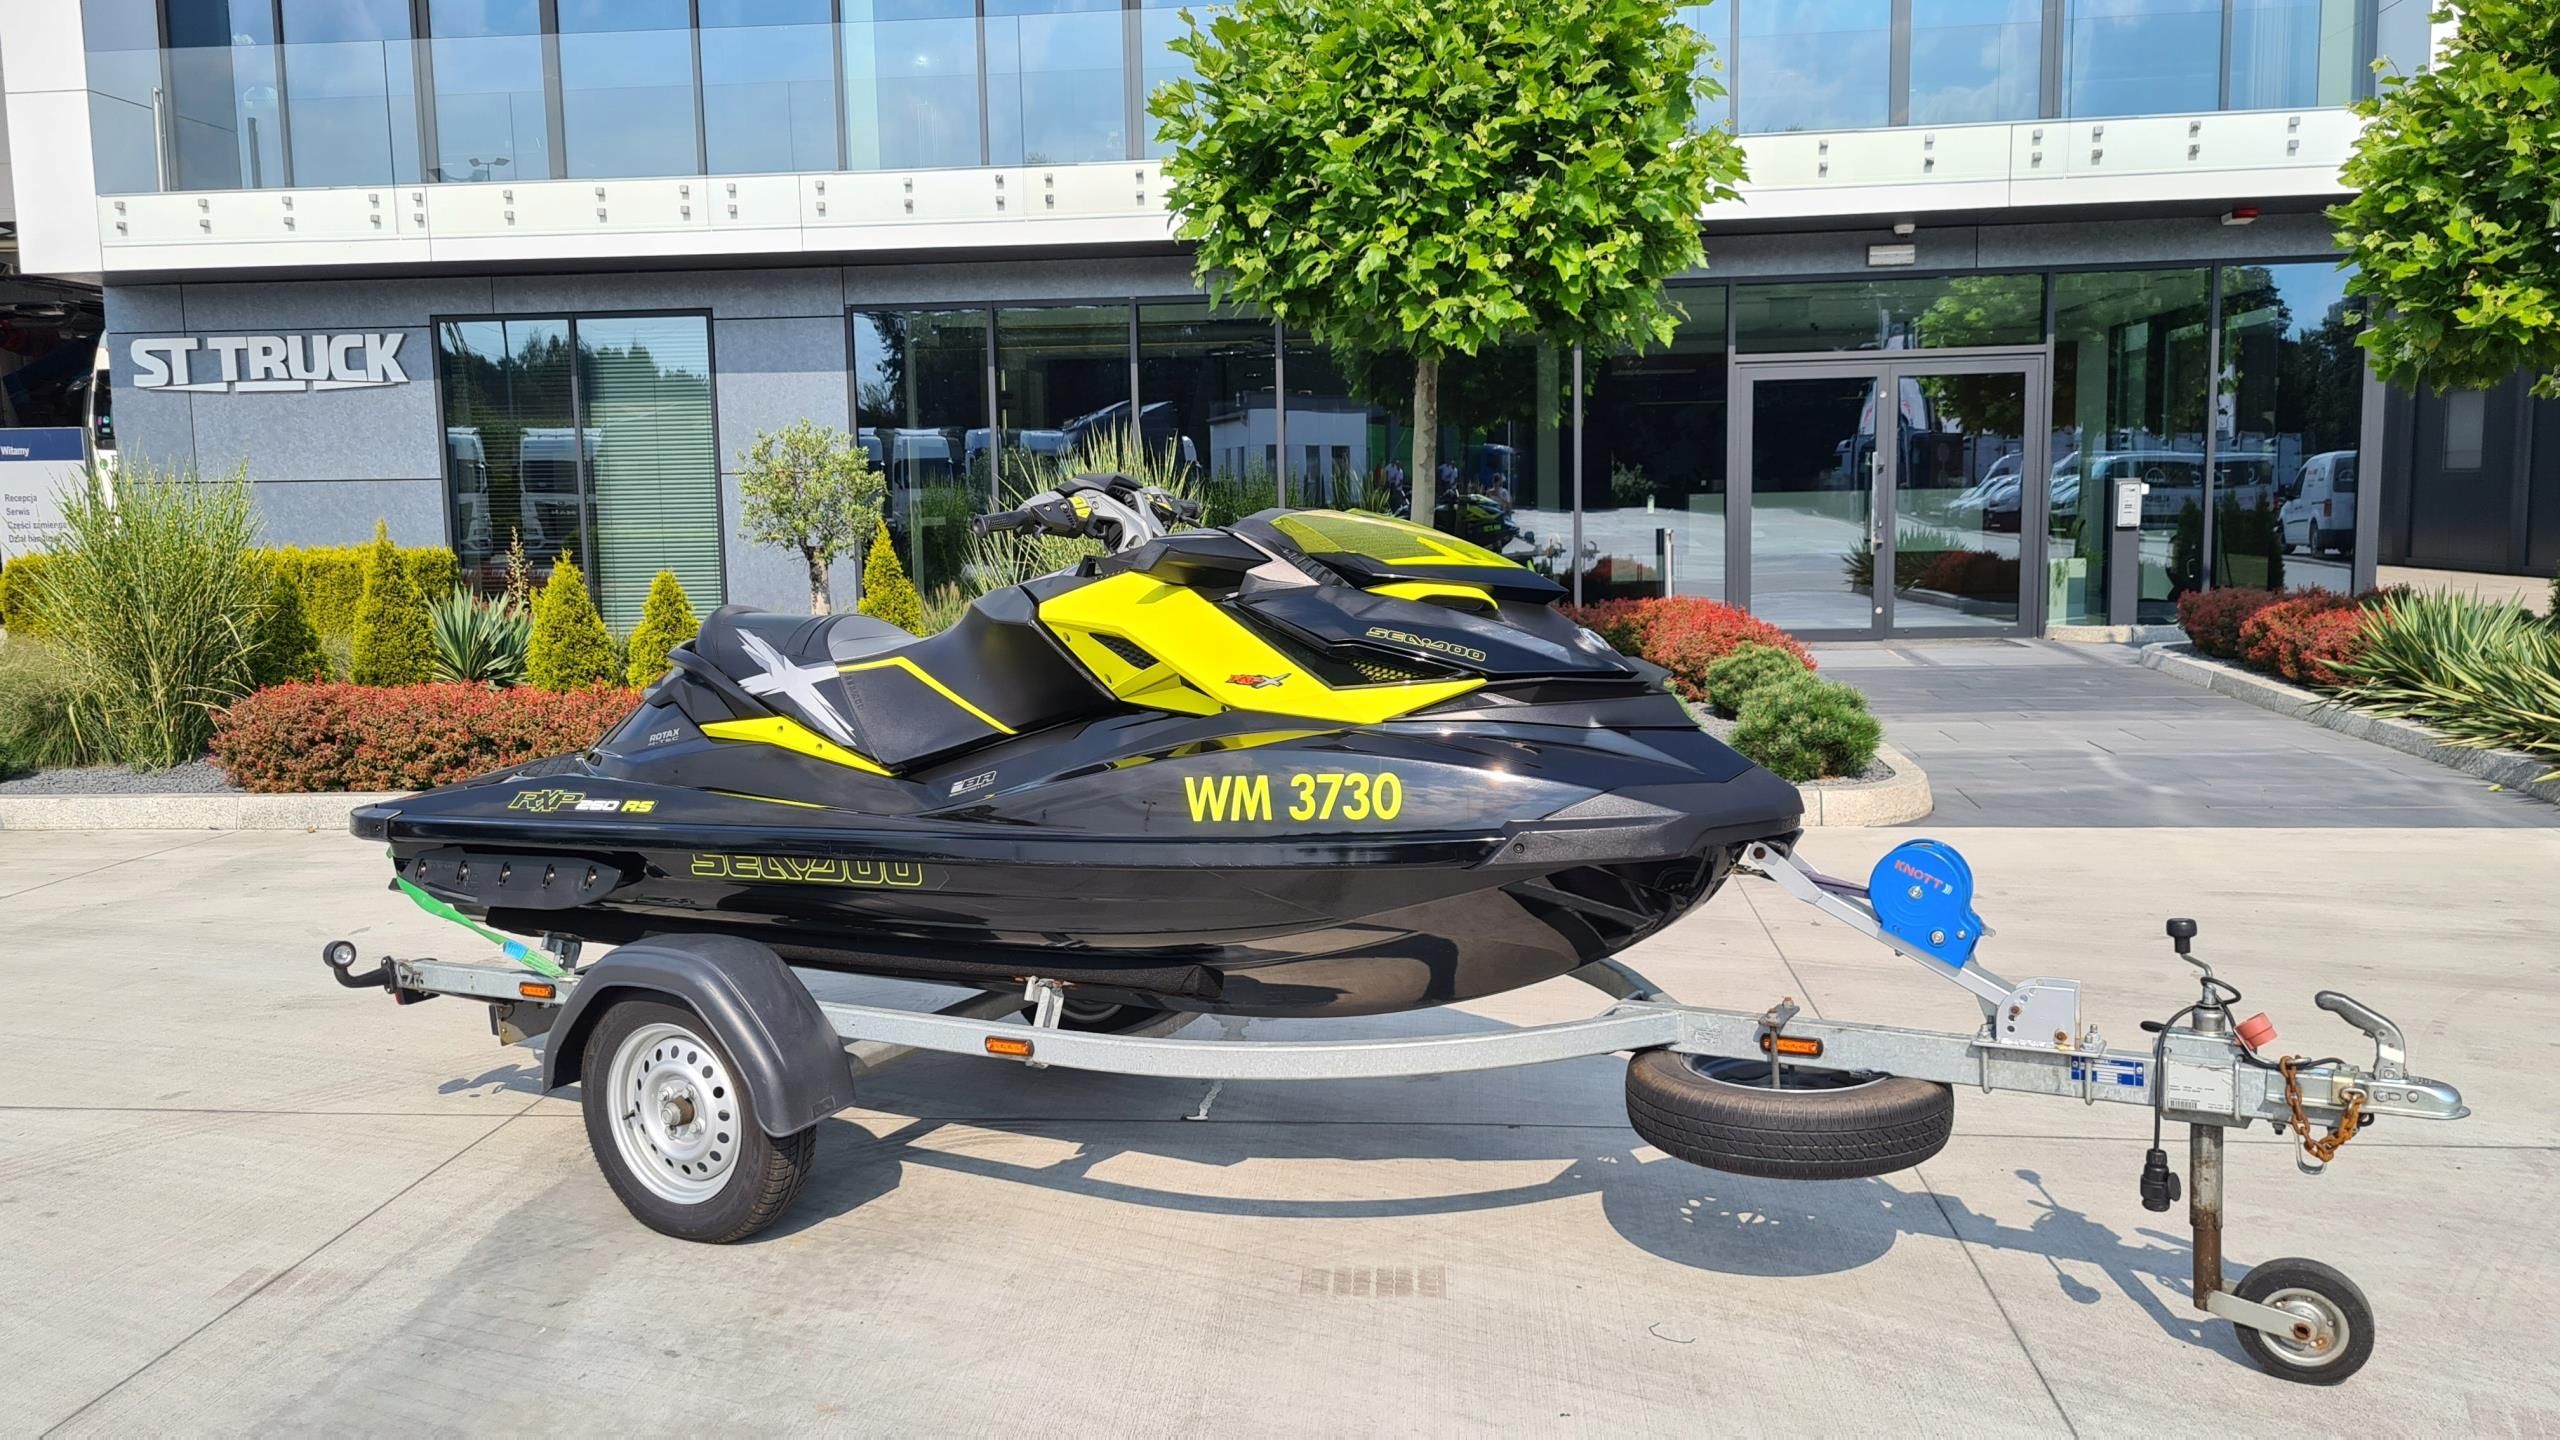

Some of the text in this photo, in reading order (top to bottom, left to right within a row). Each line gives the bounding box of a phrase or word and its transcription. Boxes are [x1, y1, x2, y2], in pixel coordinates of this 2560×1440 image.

[131, 333, 410, 387] ST TRUCK
[0, 446, 29, 457] Witamy
[4, 493, 37, 504] Recepcja
[6, 507, 30, 516] Serwis
[649, 728, 680, 742] ROTAX
[1184, 772, 1403, 822] WM 3730
[621, 800, 657, 812] RS
[1894, 860, 1944, 889] KNOTT
